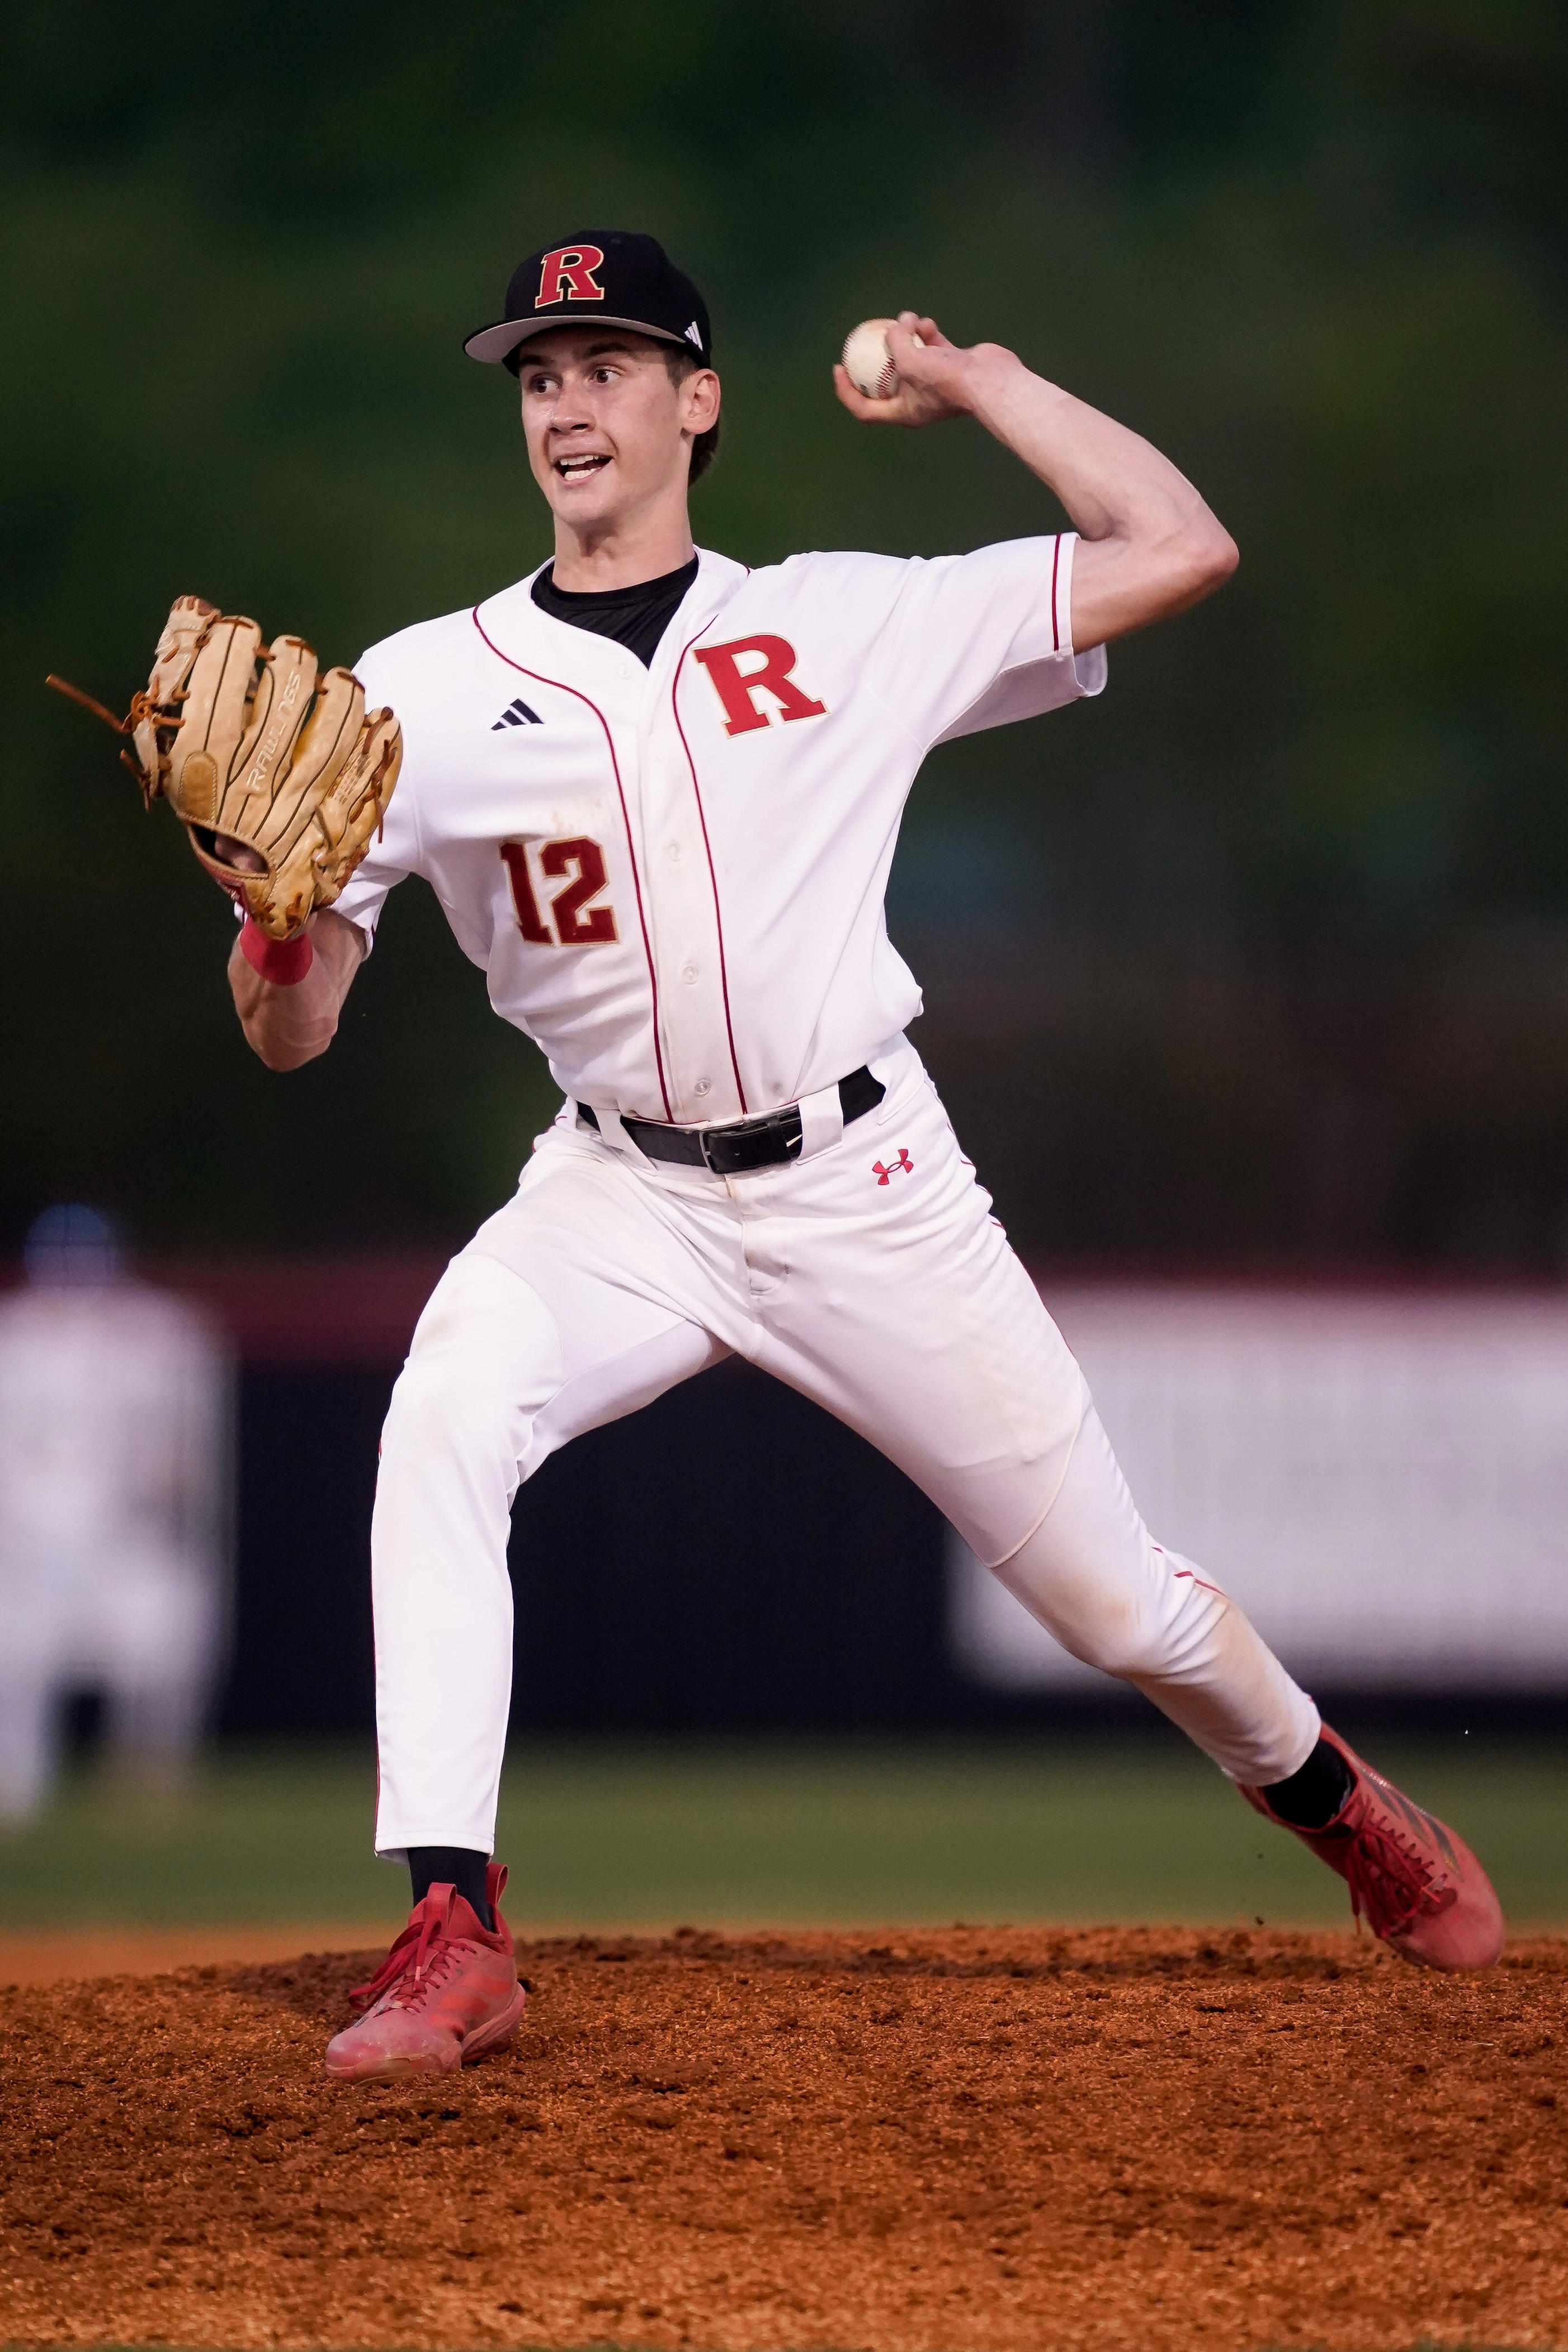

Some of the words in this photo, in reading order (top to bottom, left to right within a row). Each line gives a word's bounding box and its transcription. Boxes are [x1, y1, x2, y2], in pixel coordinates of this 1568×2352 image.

[535, 244, 605, 309] R
[691, 632, 830, 738] R
[499, 835, 620, 947] 12
